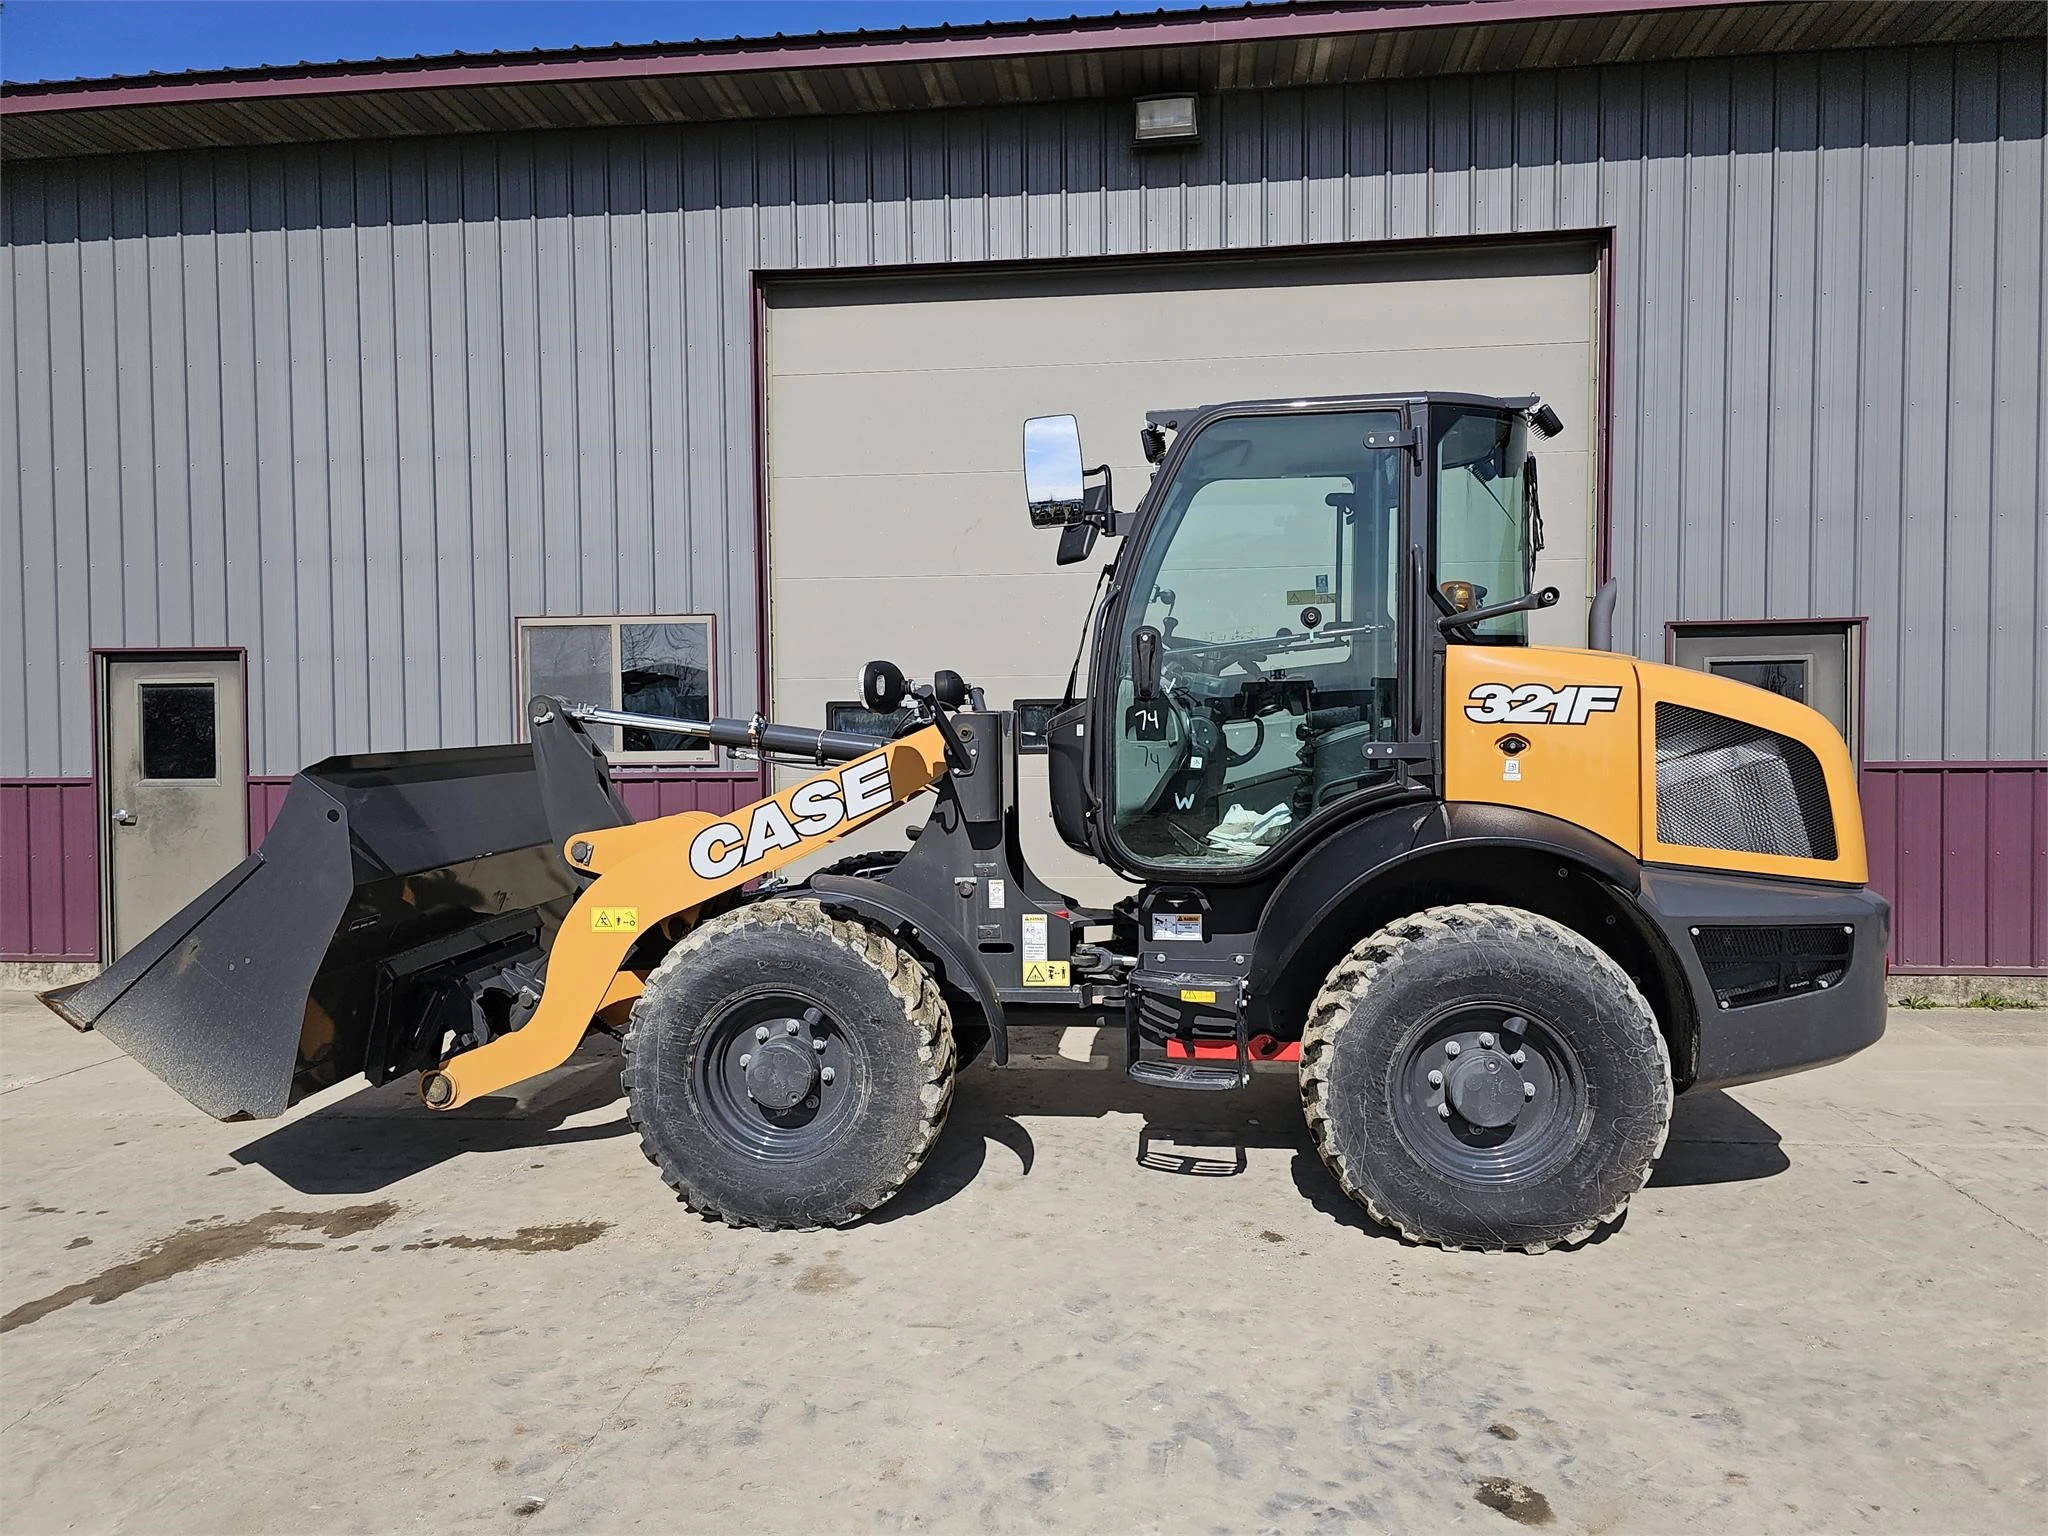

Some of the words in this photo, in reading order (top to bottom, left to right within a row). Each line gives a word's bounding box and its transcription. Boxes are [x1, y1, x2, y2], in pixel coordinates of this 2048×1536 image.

[1135, 709, 1159, 731] 74
[1464, 683, 1622, 725] 321F
[689, 752, 894, 879] CASE
[1174, 792, 1195, 810] W
